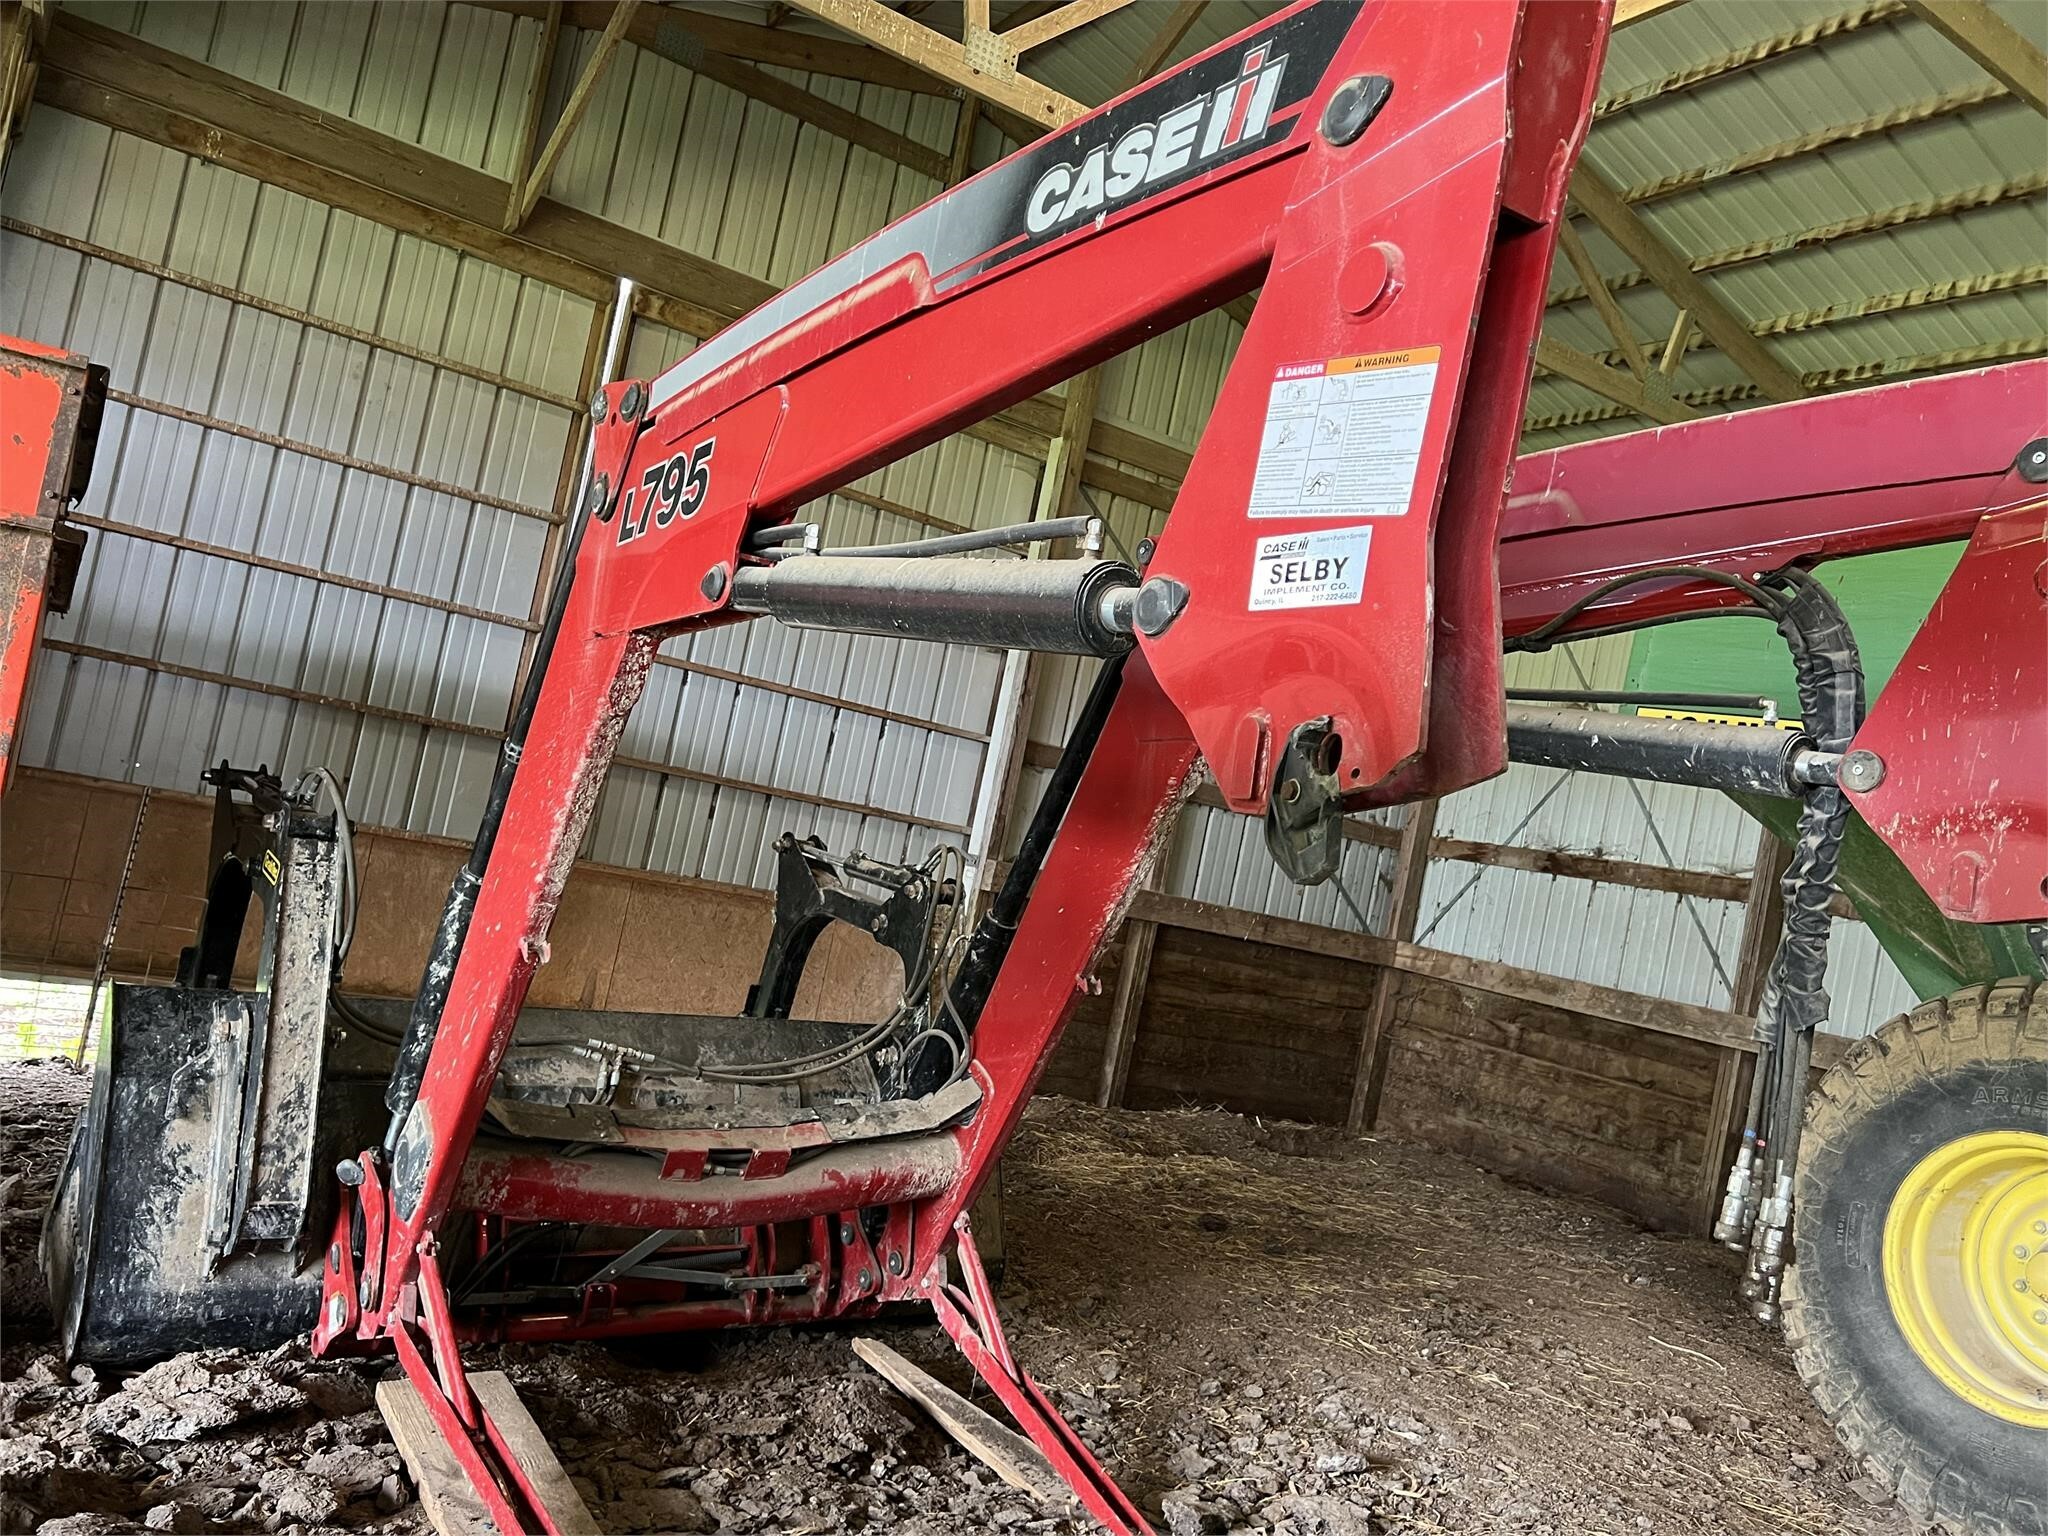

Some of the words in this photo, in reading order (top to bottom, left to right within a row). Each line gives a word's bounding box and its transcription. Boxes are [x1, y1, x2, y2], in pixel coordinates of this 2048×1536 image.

[1026, 101, 1206, 234] CASE
[1364, 354, 1409, 368] WARNING
[1285, 363, 1324, 378] DANGER
[616, 436, 716, 547] L795
[1264, 541, 1297, 554] CASE
[1270, 556, 1350, 585] SELBY
[1263, 584, 1328, 596] IMPLEMENT
[1330, 582, 1350, 591] CO.
